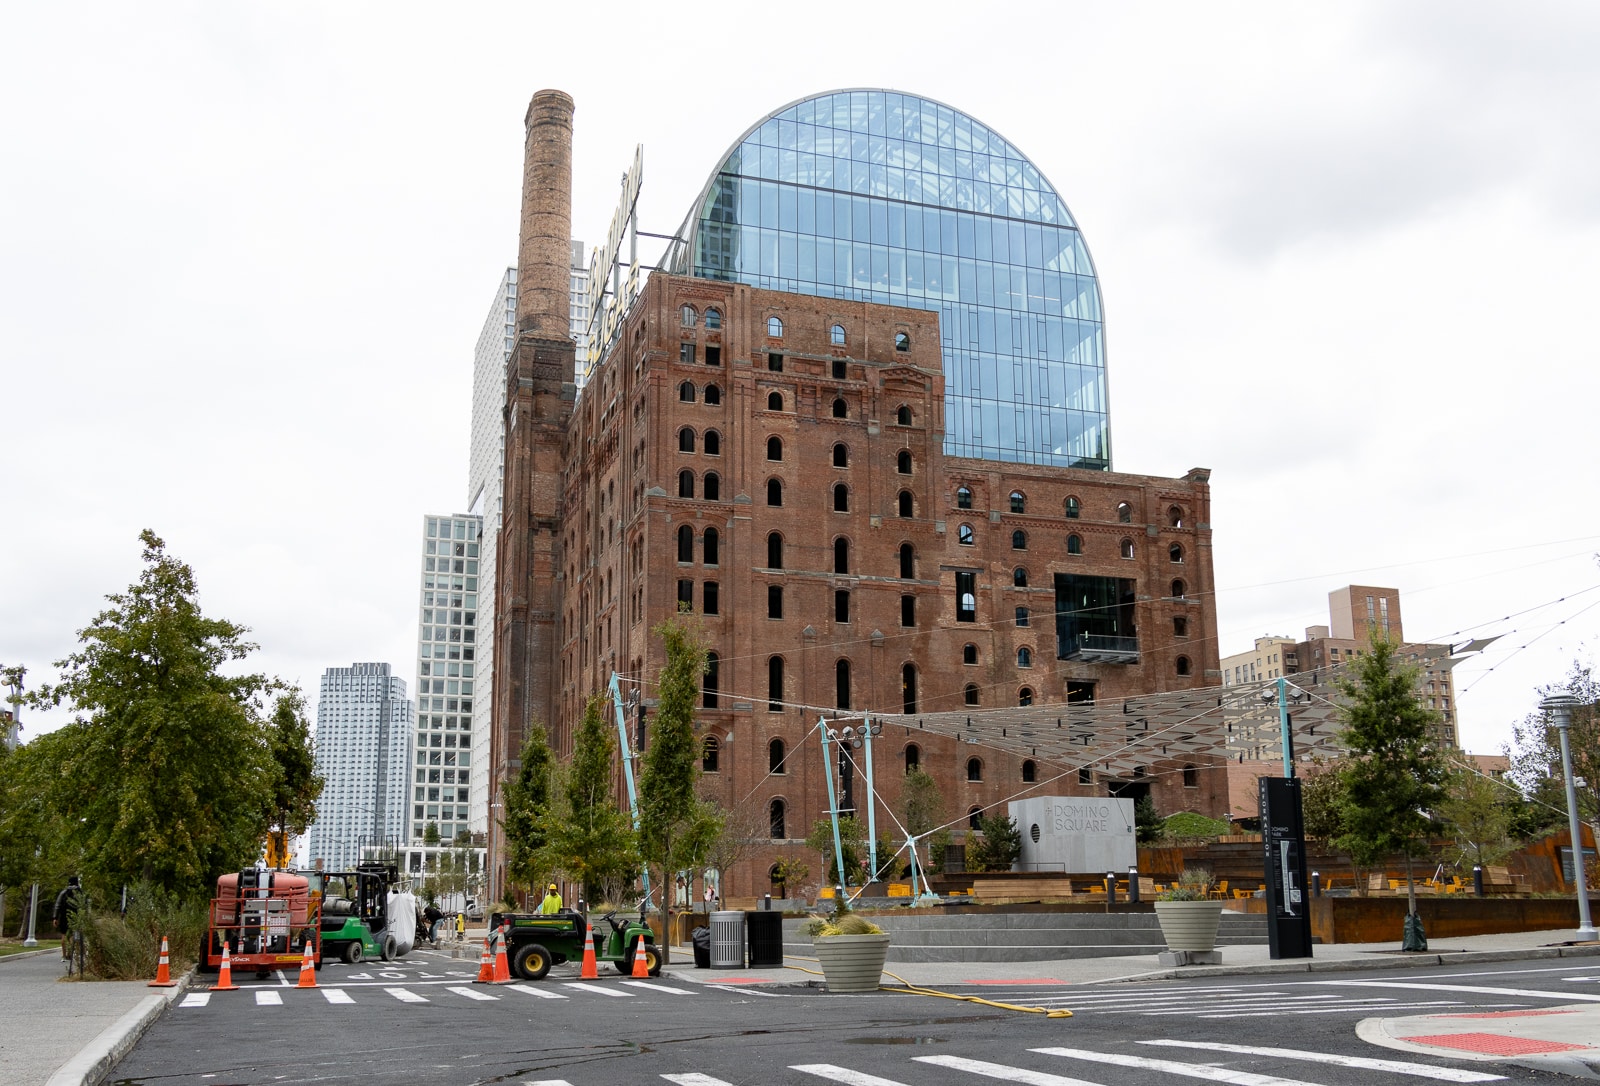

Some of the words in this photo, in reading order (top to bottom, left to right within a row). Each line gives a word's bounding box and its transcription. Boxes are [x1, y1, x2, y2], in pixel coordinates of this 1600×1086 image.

[1054, 805, 1110, 818] DOMINO
[1261, 779, 1270, 857] INFORMATION
[1055, 818, 1108, 832] SQUARE
[347, 971, 477, 980] STOP
